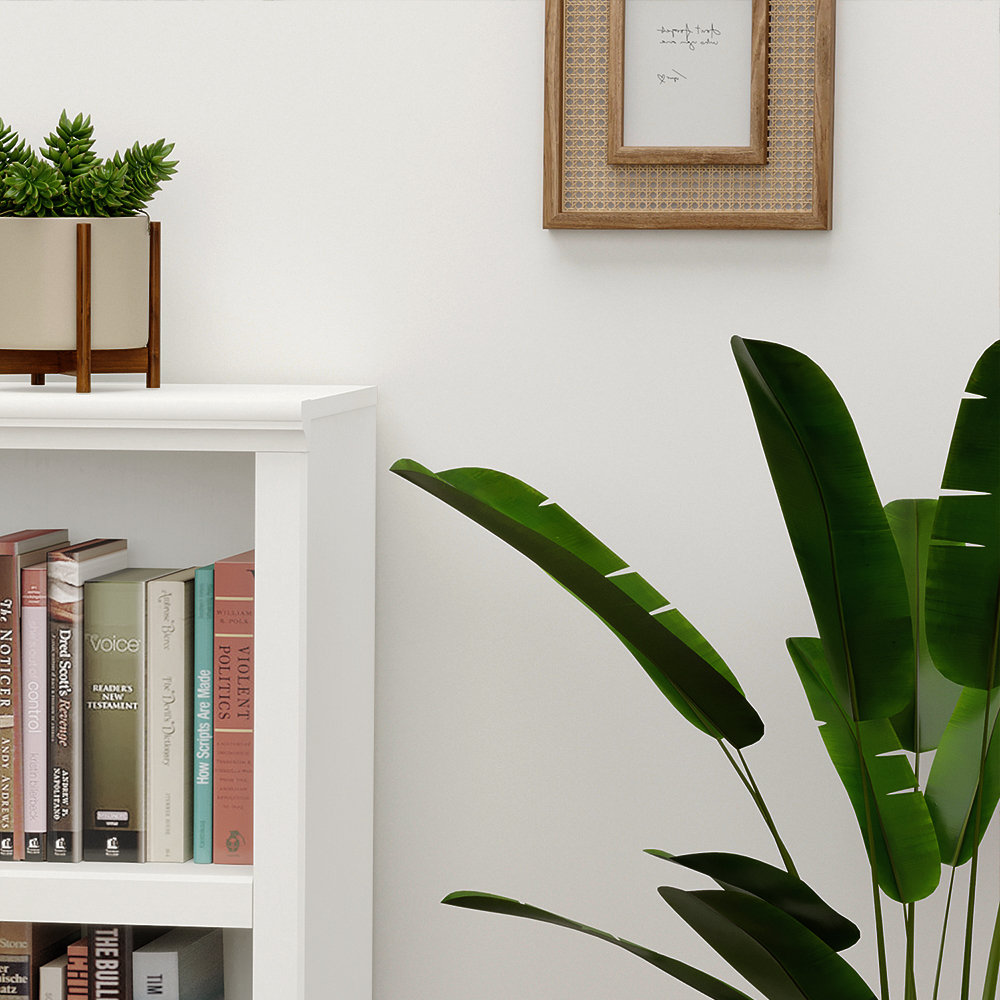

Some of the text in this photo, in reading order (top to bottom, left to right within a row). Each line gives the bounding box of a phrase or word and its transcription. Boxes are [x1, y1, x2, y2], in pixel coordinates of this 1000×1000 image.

[0, 599, 13, 707] The NOTICER
[57, 629, 72, 747] Dred Scott's Revenge
[218, 645, 232, 720] POLITICS
[237, 646, 251, 720] VIOLENT
[197, 670, 212, 784] How Scripts Are Made
[1, 737, 10, 829] ANDY ANDREWS
[0, 938, 28, 948] Stone
[95, 928, 119, 957] THE
[147, 974, 163, 995] TIM
